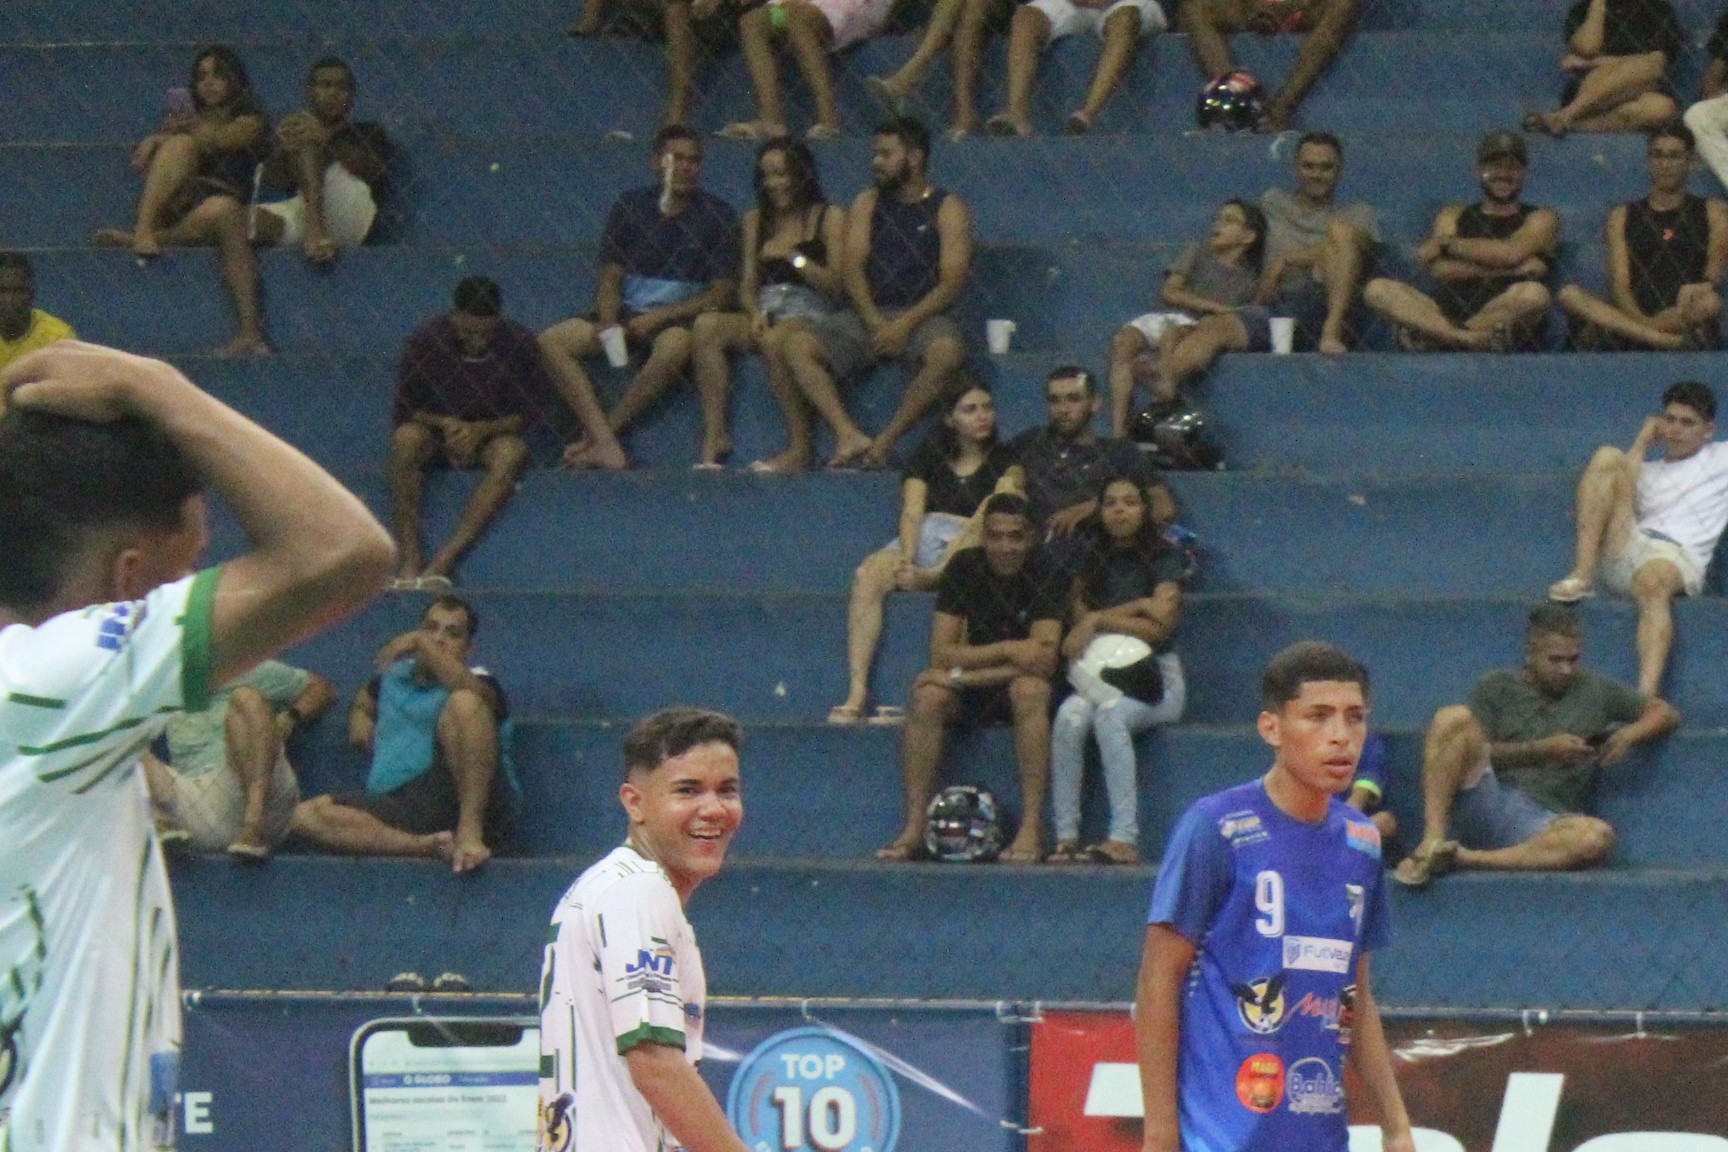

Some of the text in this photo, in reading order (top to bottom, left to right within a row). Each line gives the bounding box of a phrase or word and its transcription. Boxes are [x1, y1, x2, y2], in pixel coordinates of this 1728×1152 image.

[1255, 870, 1285, 938] 9
[780, 1053, 846, 1080] TOP
[772, 1085, 856, 1152] 10
